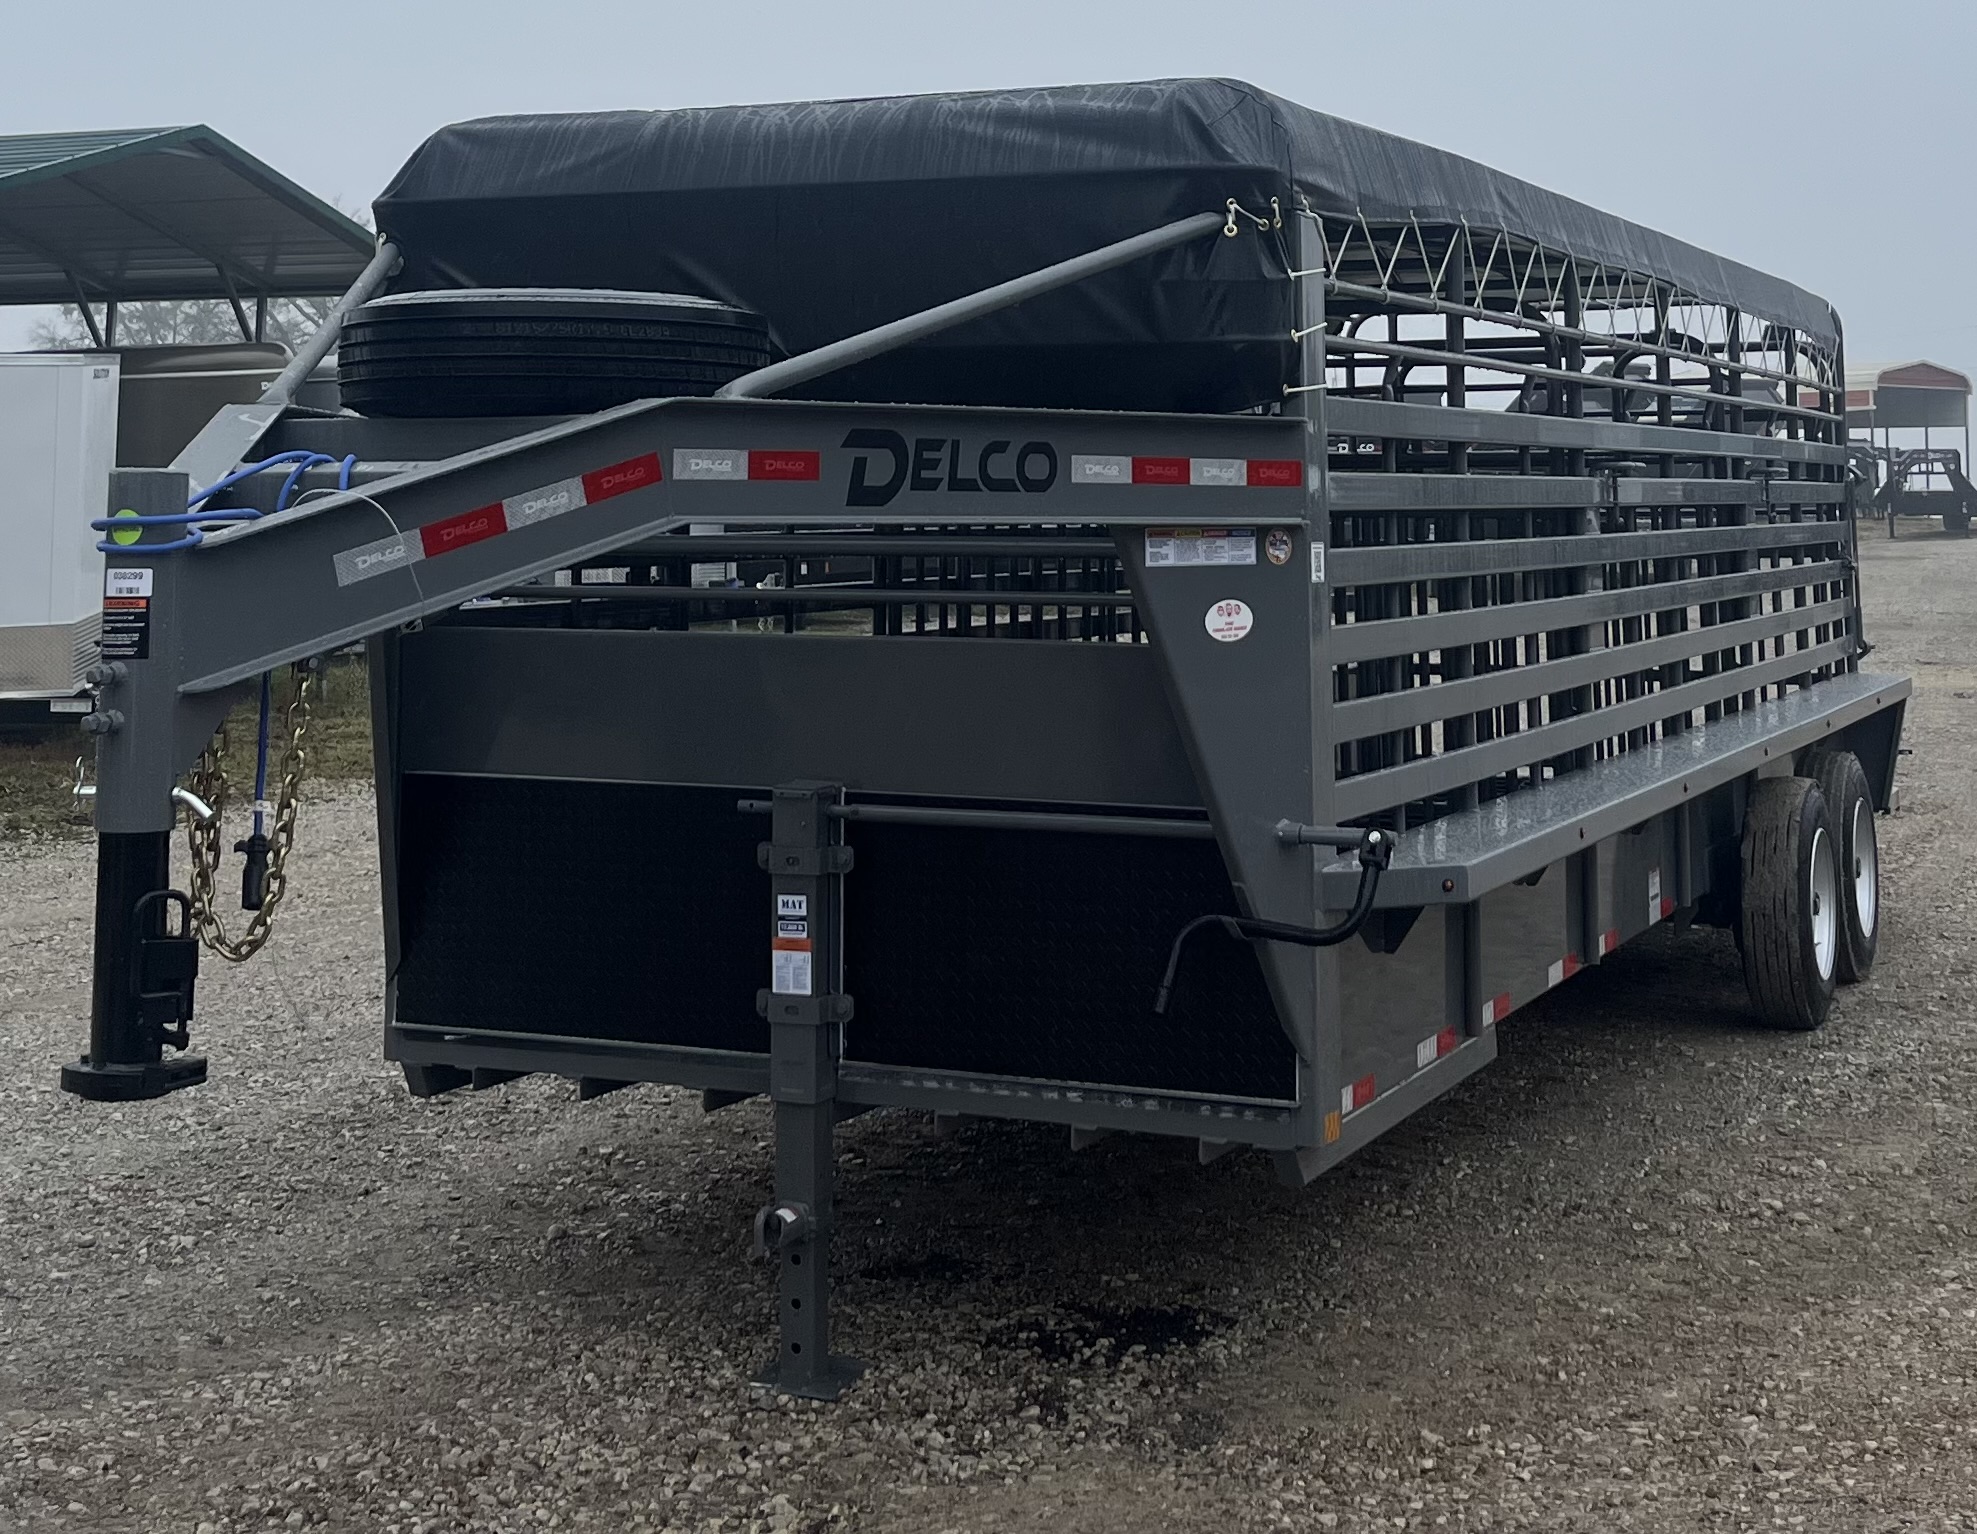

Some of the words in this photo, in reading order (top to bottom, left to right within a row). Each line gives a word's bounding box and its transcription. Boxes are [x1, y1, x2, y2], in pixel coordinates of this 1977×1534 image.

[689, 458, 732, 472] DELCO
[764, 459, 805, 472] DELCO
[840, 428, 1058, 507] DELCO
[601, 466, 646, 490] DELCO
[522, 491, 569, 515] DELCO
[440, 518, 489, 542] DELCO
[355, 545, 405, 570] DELCO
[781, 899, 804, 910] MAT
